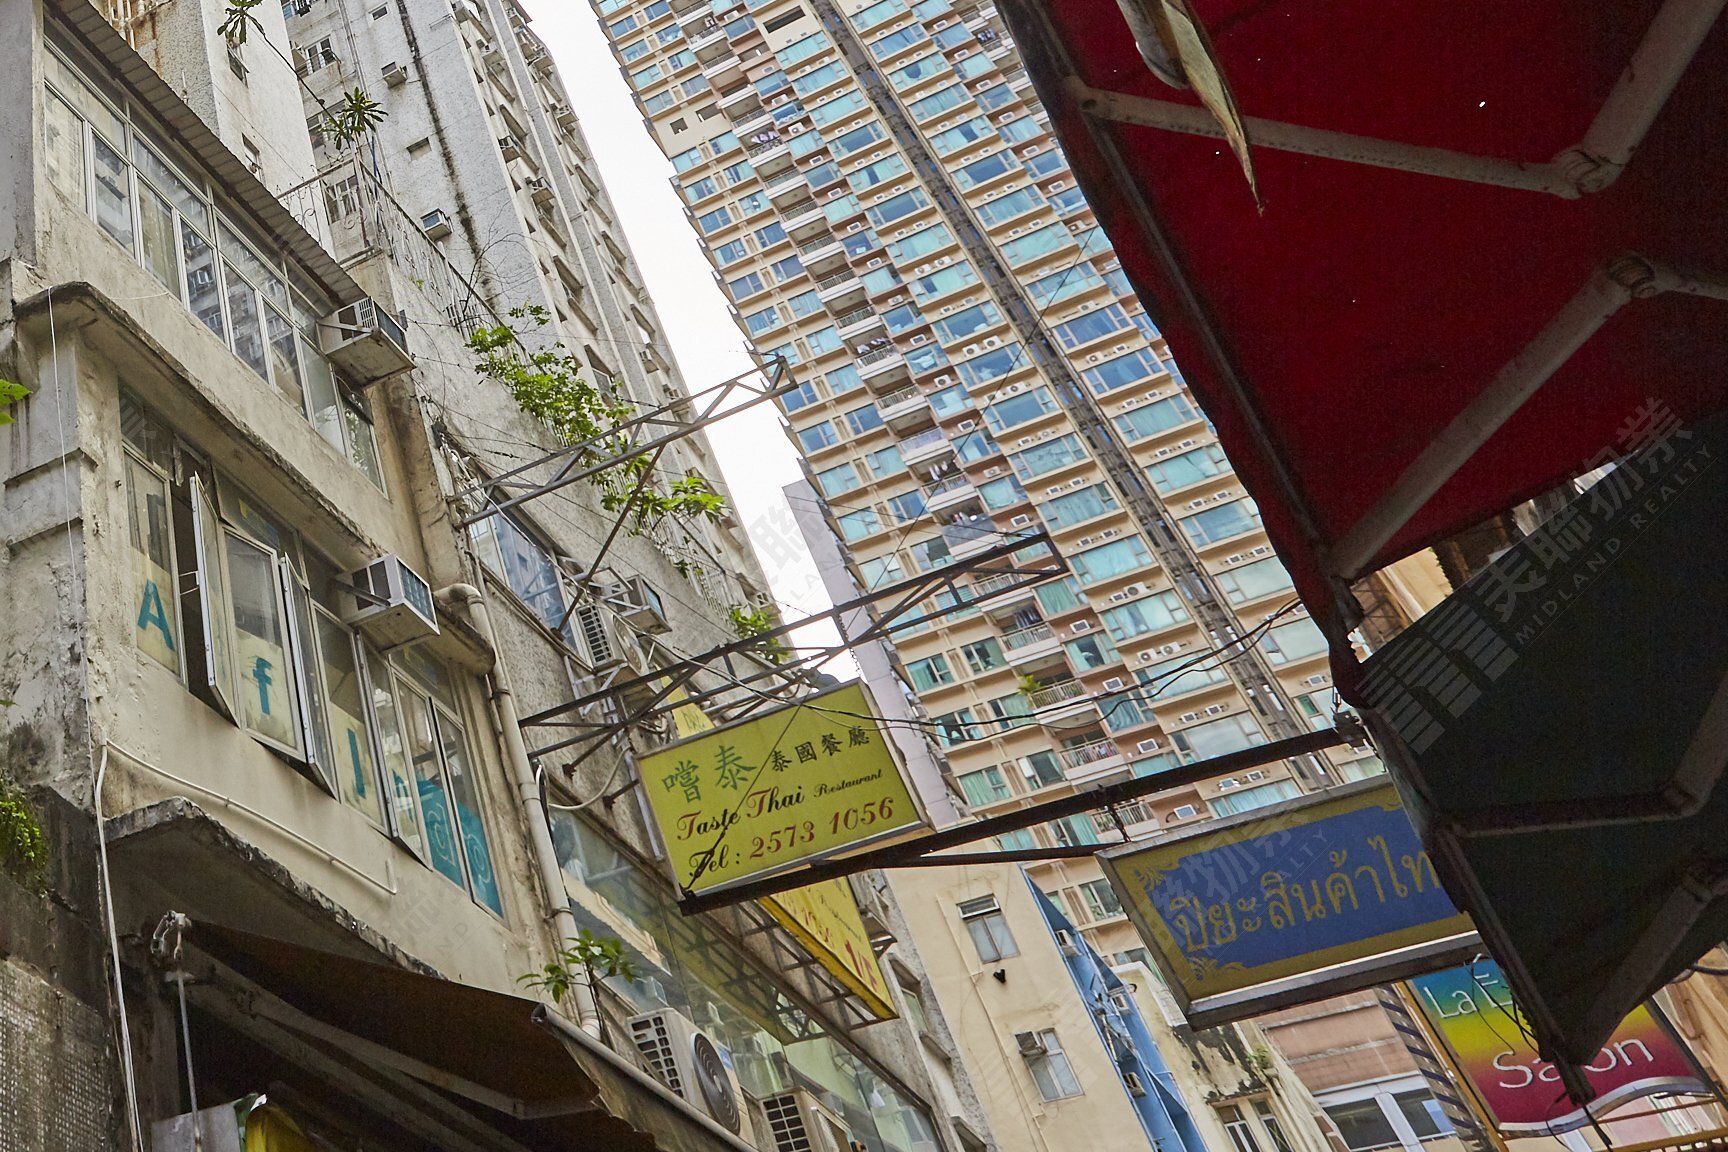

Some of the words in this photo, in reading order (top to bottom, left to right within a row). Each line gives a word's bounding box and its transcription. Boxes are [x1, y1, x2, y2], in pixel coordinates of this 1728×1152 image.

[662, 745, 756, 804] 嚐泰
[771, 725, 870, 772] 泰國餐廳
[677, 809, 741, 841] Taste
[747, 785, 805, 819] Thai
[813, 769, 882, 799] Restaurant
[749, 821, 815, 860] 2573
[830, 797, 894, 836] 1056
[1170, 835, 1441, 951] ปิยะสินค้าไท
[1492, 1039, 1654, 1088] Saon
